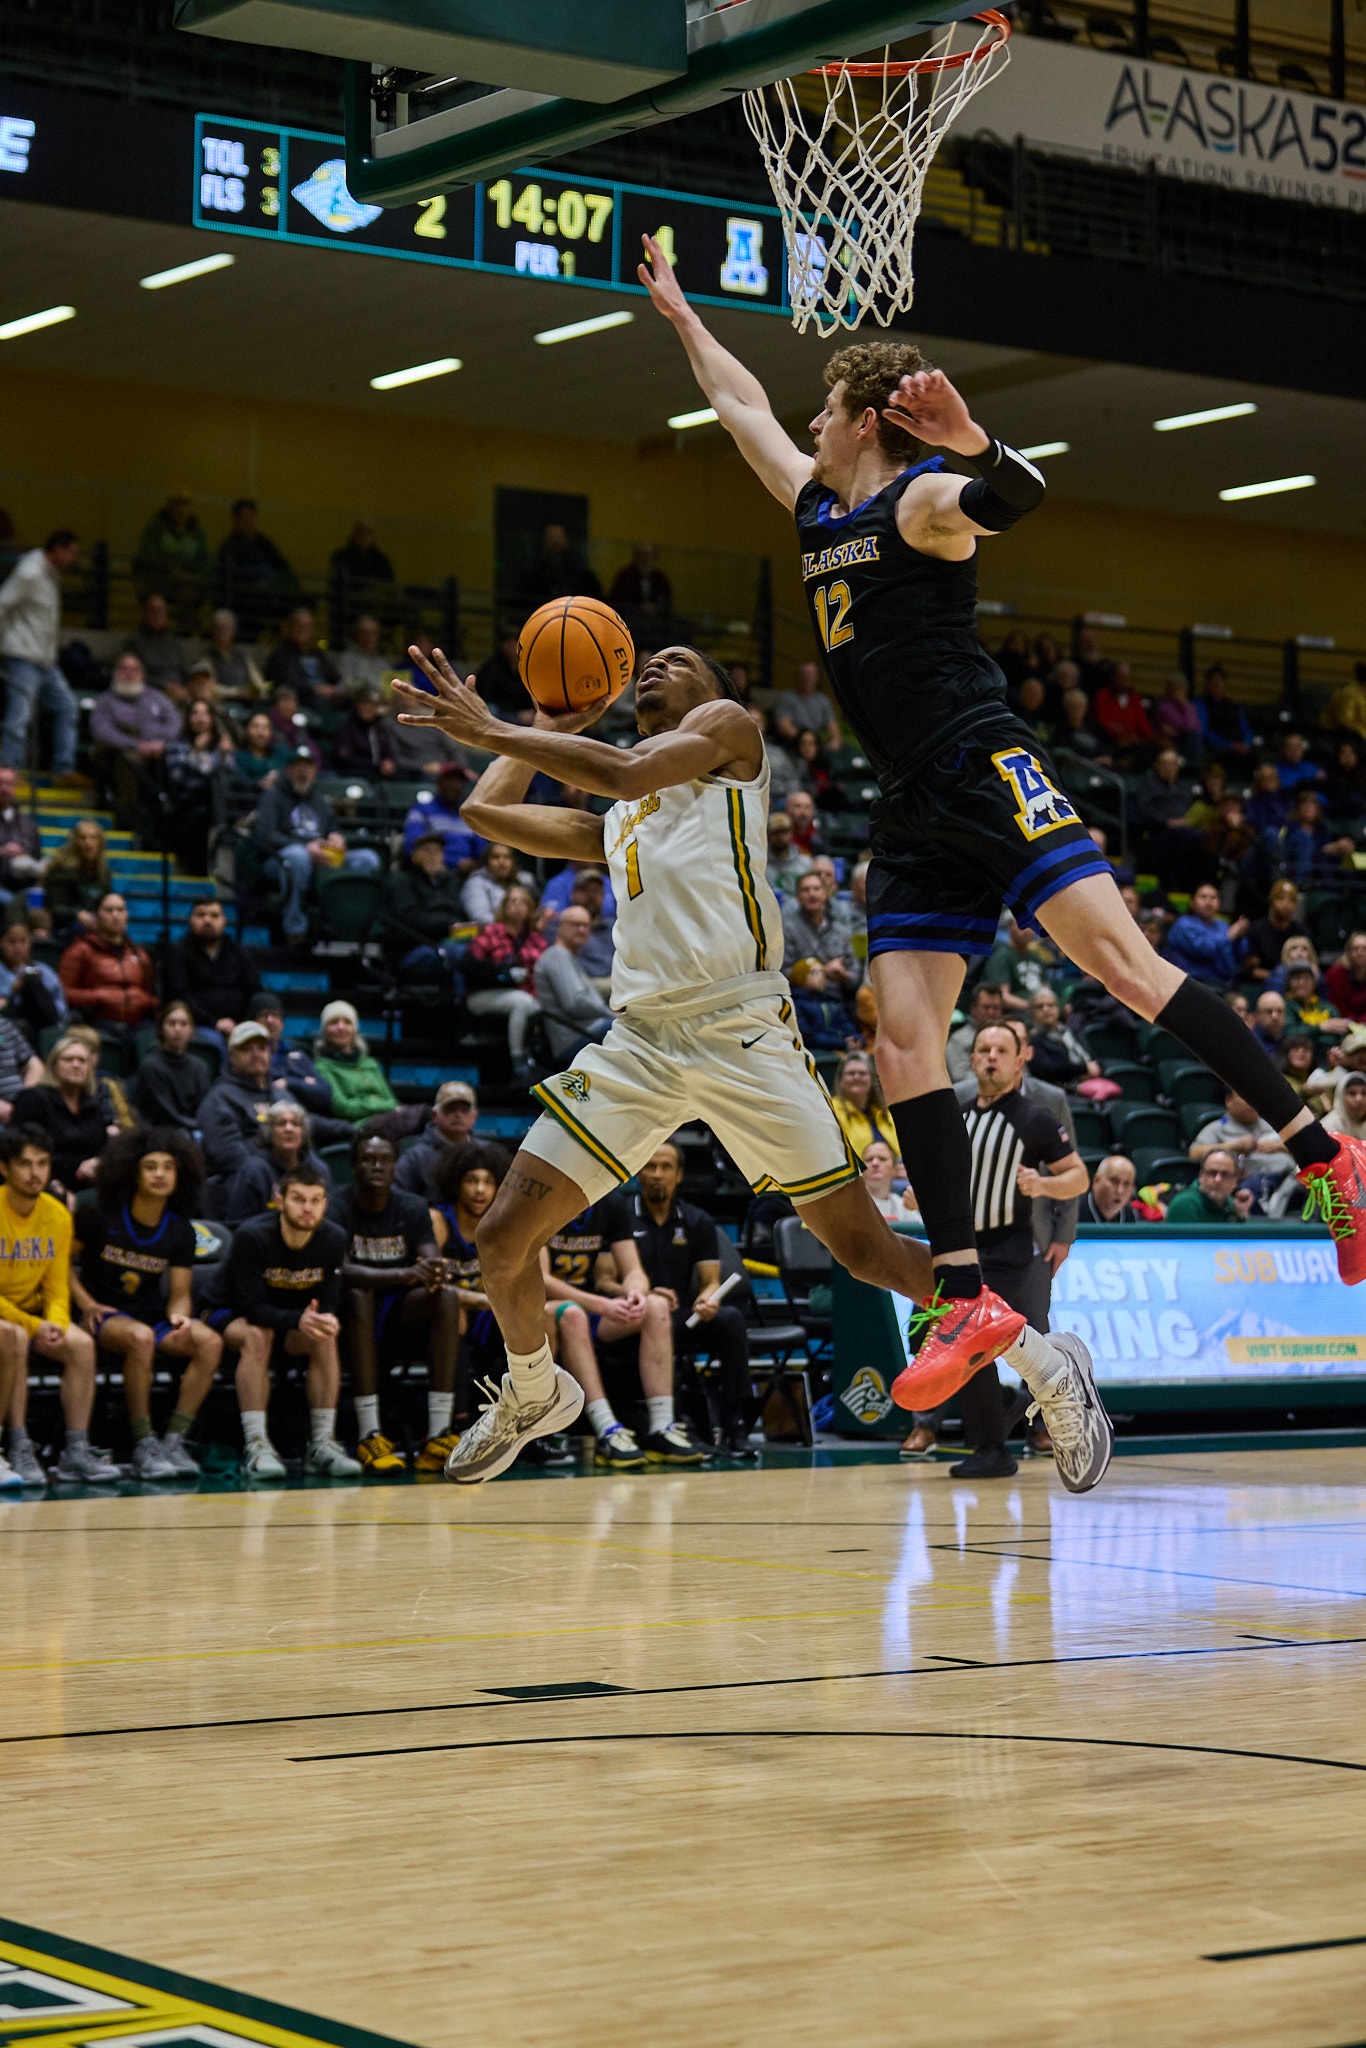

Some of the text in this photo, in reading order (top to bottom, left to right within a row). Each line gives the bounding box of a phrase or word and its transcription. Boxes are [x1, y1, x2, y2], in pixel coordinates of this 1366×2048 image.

[261, 147, 280, 177] 3
[260, 187, 280, 216] 3
[413, 194, 447, 239] 2
[487, 179, 614, 243] 14:07
[515, 240, 577, 282] PER 1
[801, 536, 880, 582] LASKA
[814, 579, 854, 653] 12
[625, 838, 644, 901] 1
[550, 1253, 590, 1284] 22
[1050, 1309, 1199, 1359] RING
